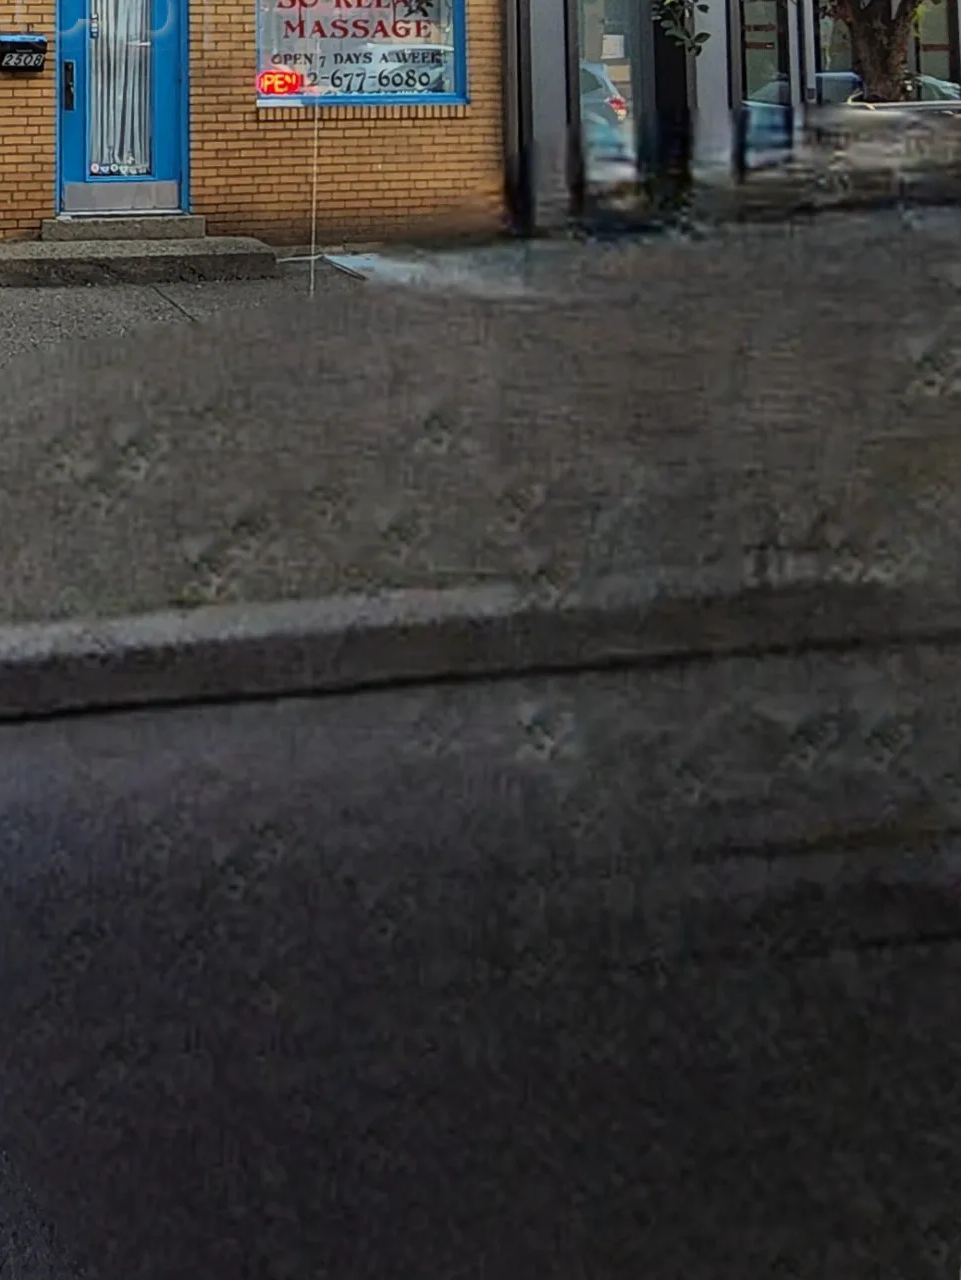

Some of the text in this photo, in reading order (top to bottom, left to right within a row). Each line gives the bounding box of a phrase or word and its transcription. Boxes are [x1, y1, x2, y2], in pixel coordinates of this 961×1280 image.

[283, 19, 432, 39] MASSAGE
[4, 54, 43, 67] 2508
[270, 53, 314, 65] OPEN
[319, 55, 326, 68] 7
[333, 52, 373, 64] DAYS
[379, 53, 388, 64] A
[260, 73, 297, 93] PEN
[292, 69, 431, 92] 12-677-6080
